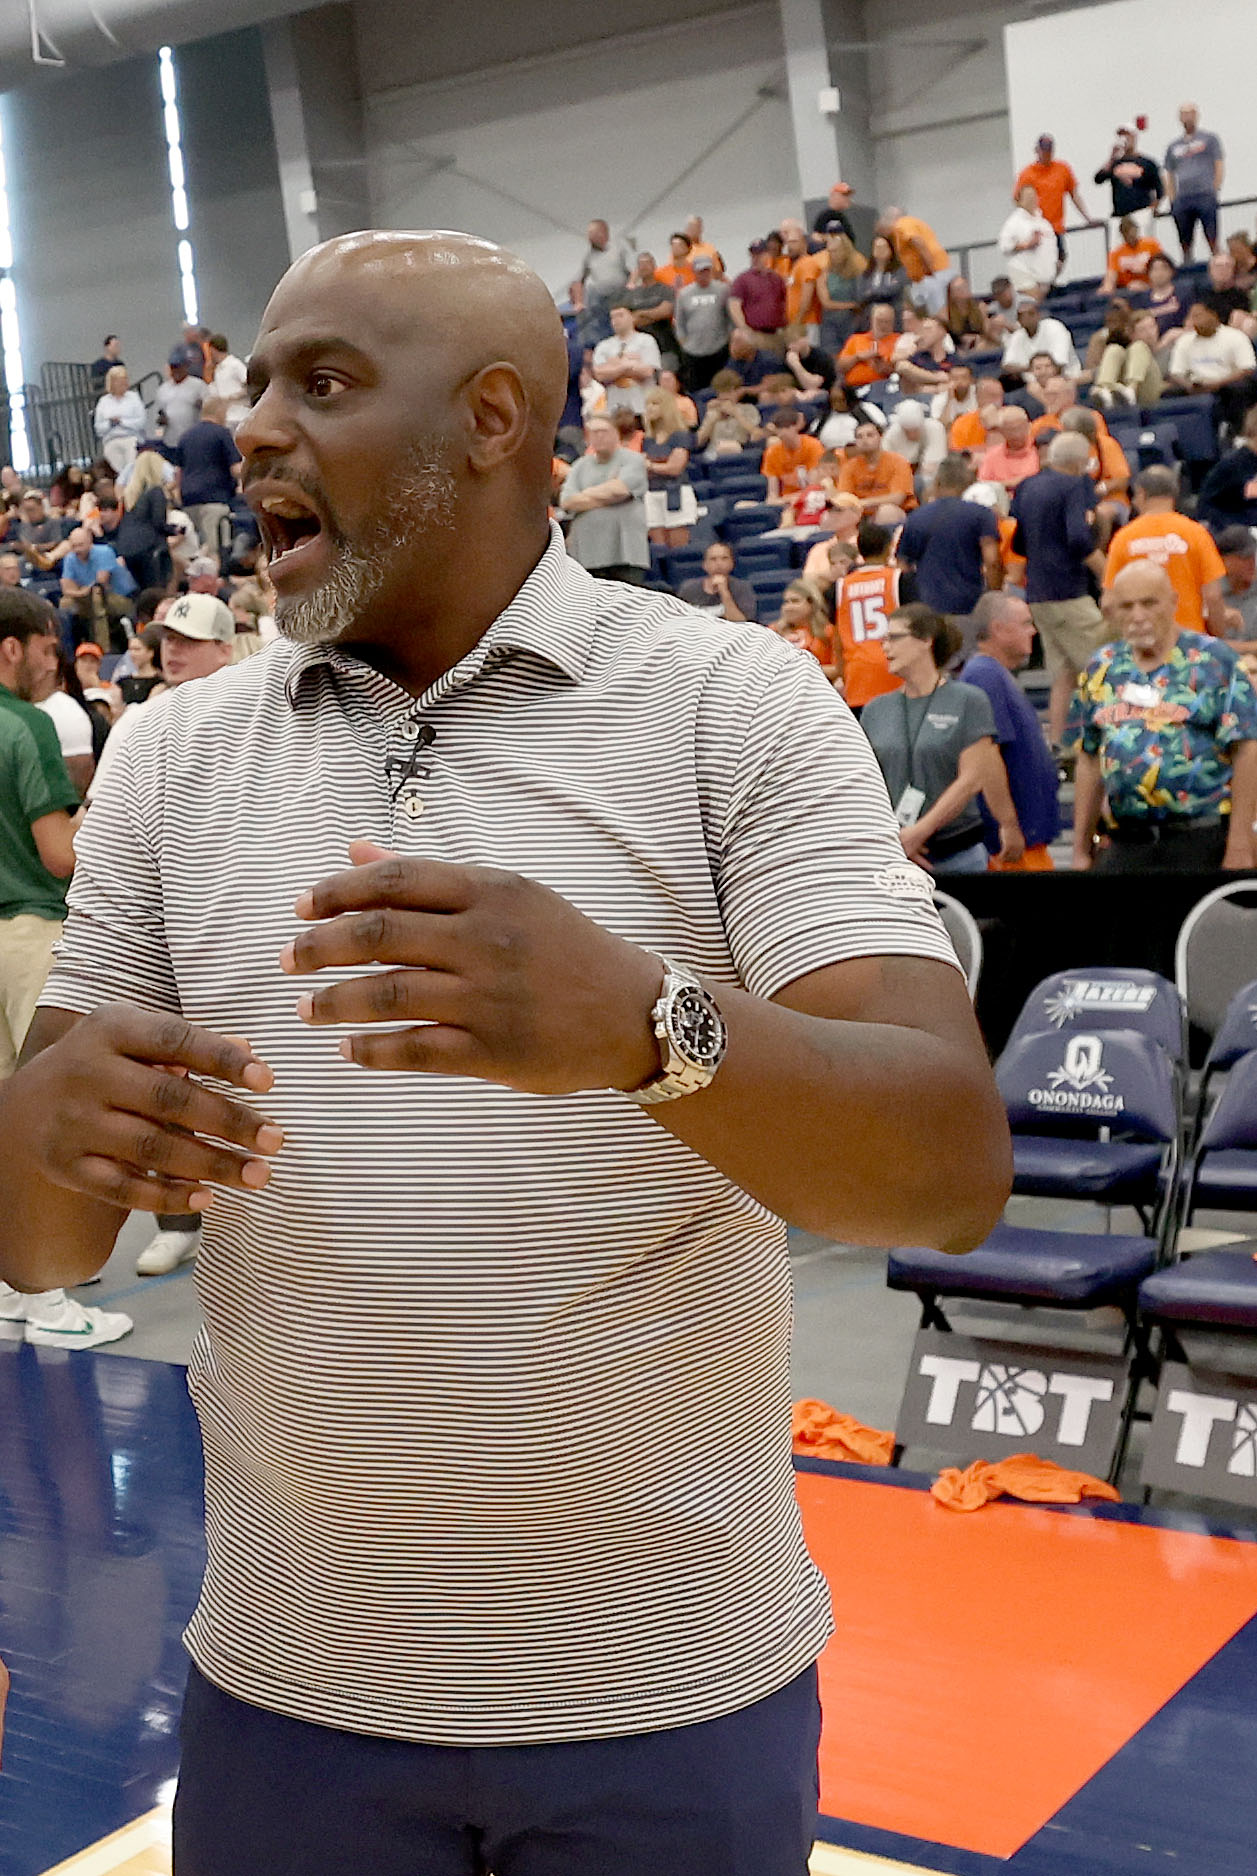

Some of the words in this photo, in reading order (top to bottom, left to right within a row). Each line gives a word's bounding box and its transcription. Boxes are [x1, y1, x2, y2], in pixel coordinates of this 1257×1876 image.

[850, 595, 889, 643] 15
[1027, 1088, 1125, 1110] ONONDAGA
[919, 1355, 1114, 1446] TBT
